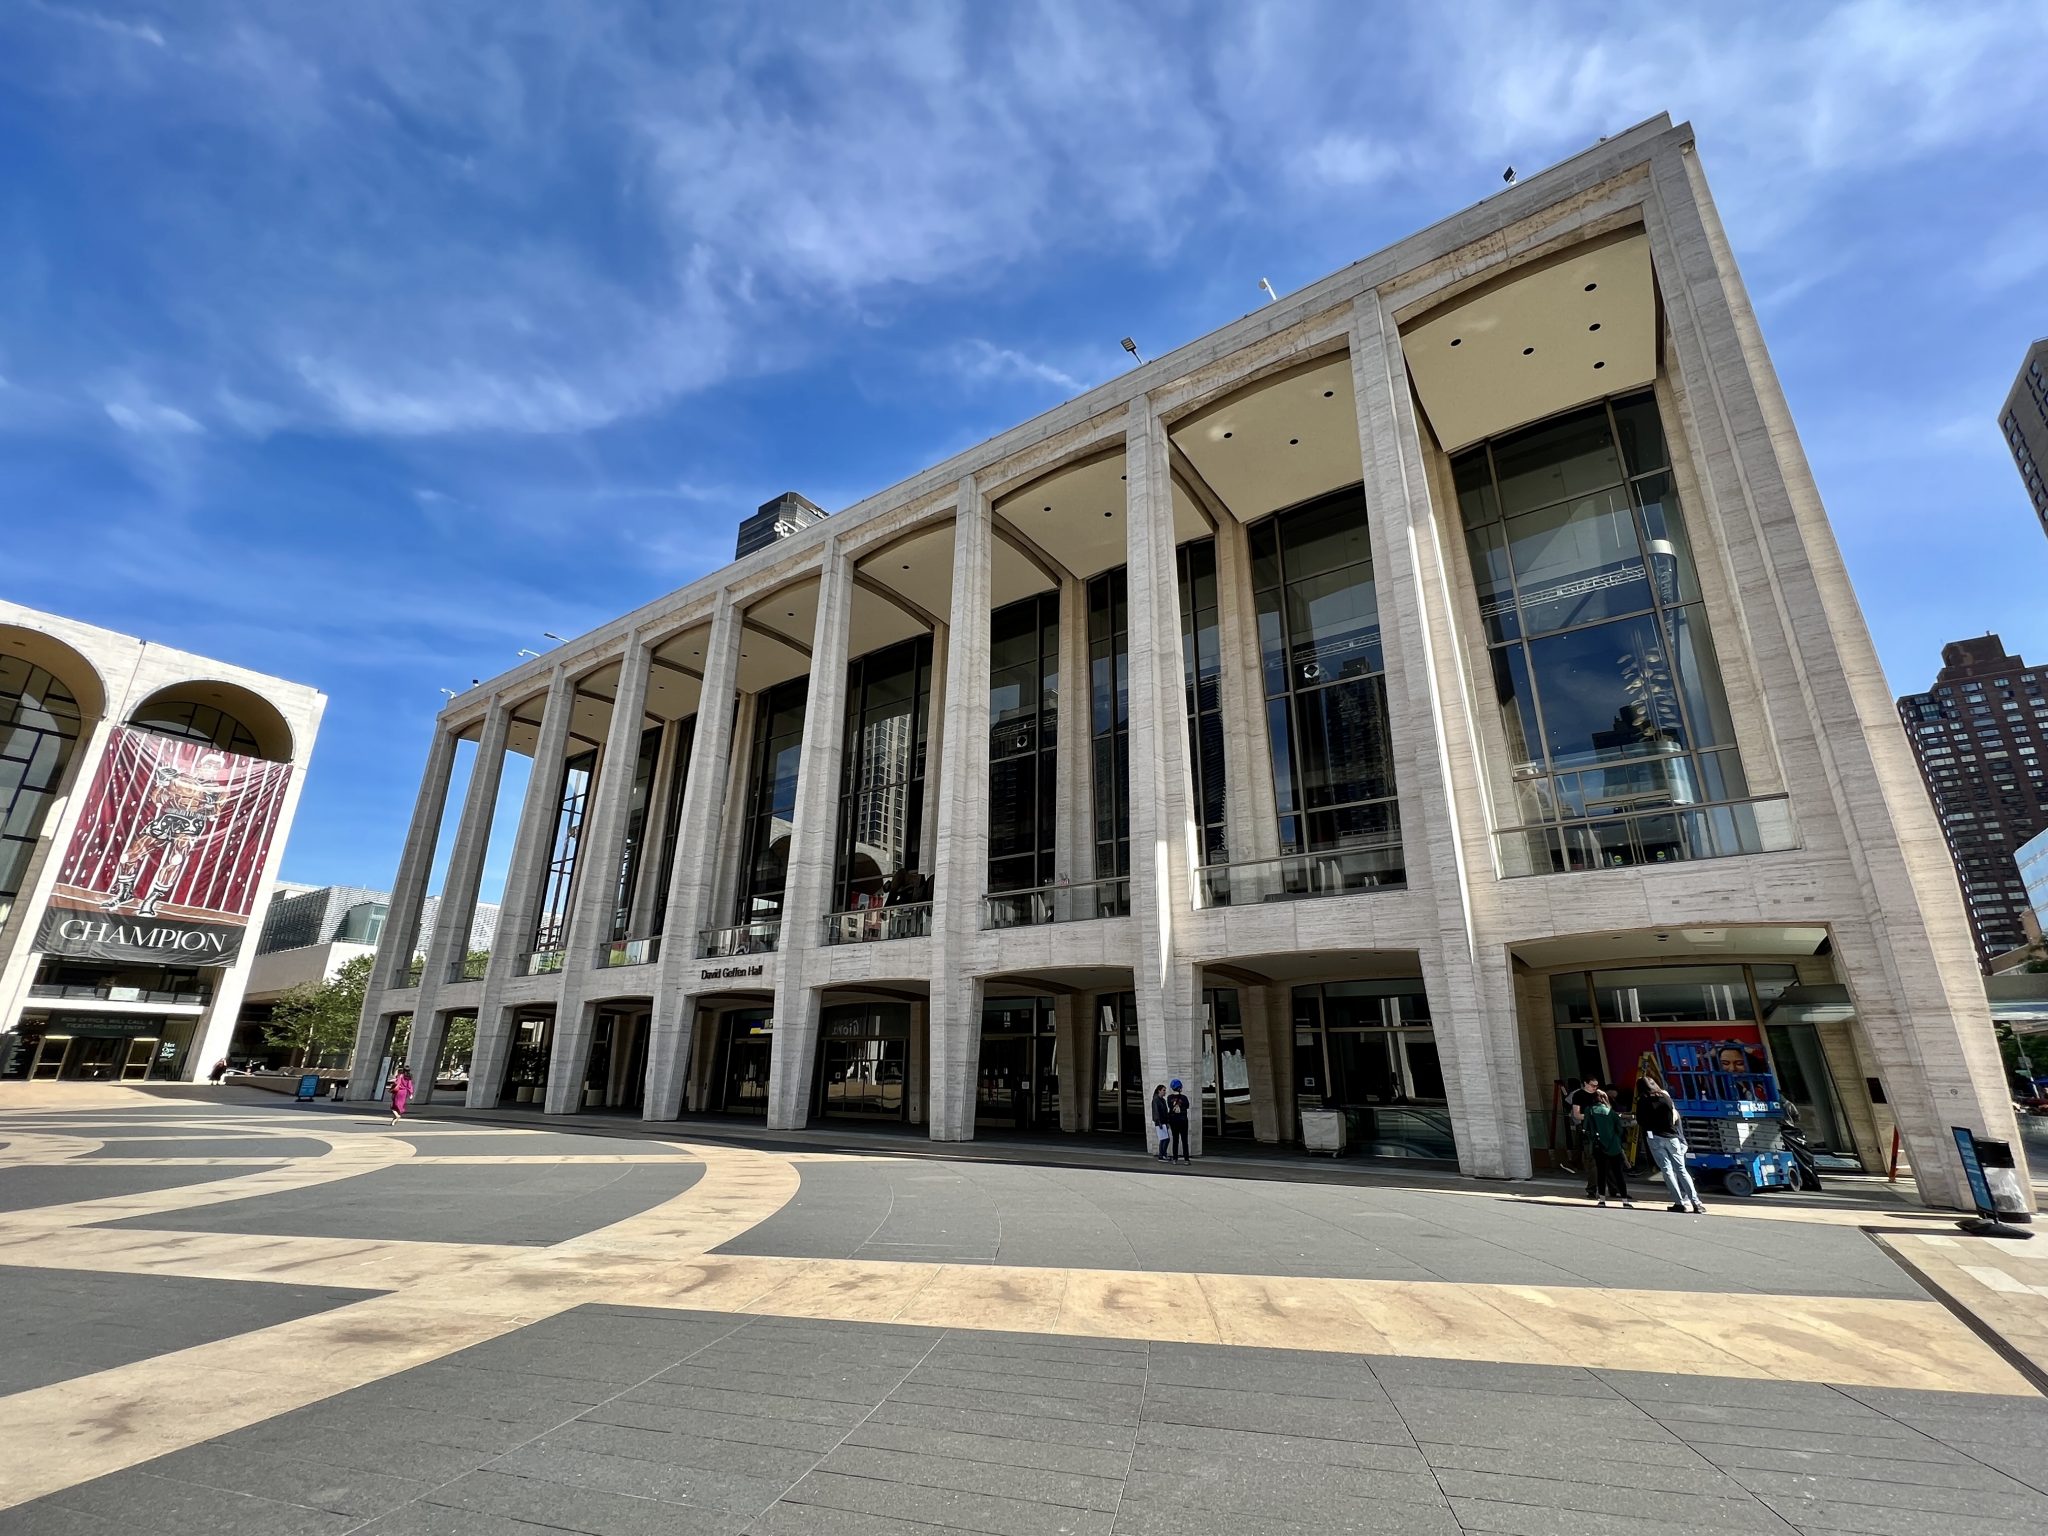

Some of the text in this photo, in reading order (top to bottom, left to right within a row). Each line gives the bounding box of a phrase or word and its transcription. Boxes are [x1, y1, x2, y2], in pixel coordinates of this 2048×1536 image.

[59, 919, 228, 953] CHAMPION
[701, 965, 763, 980] David Geffen Hall
